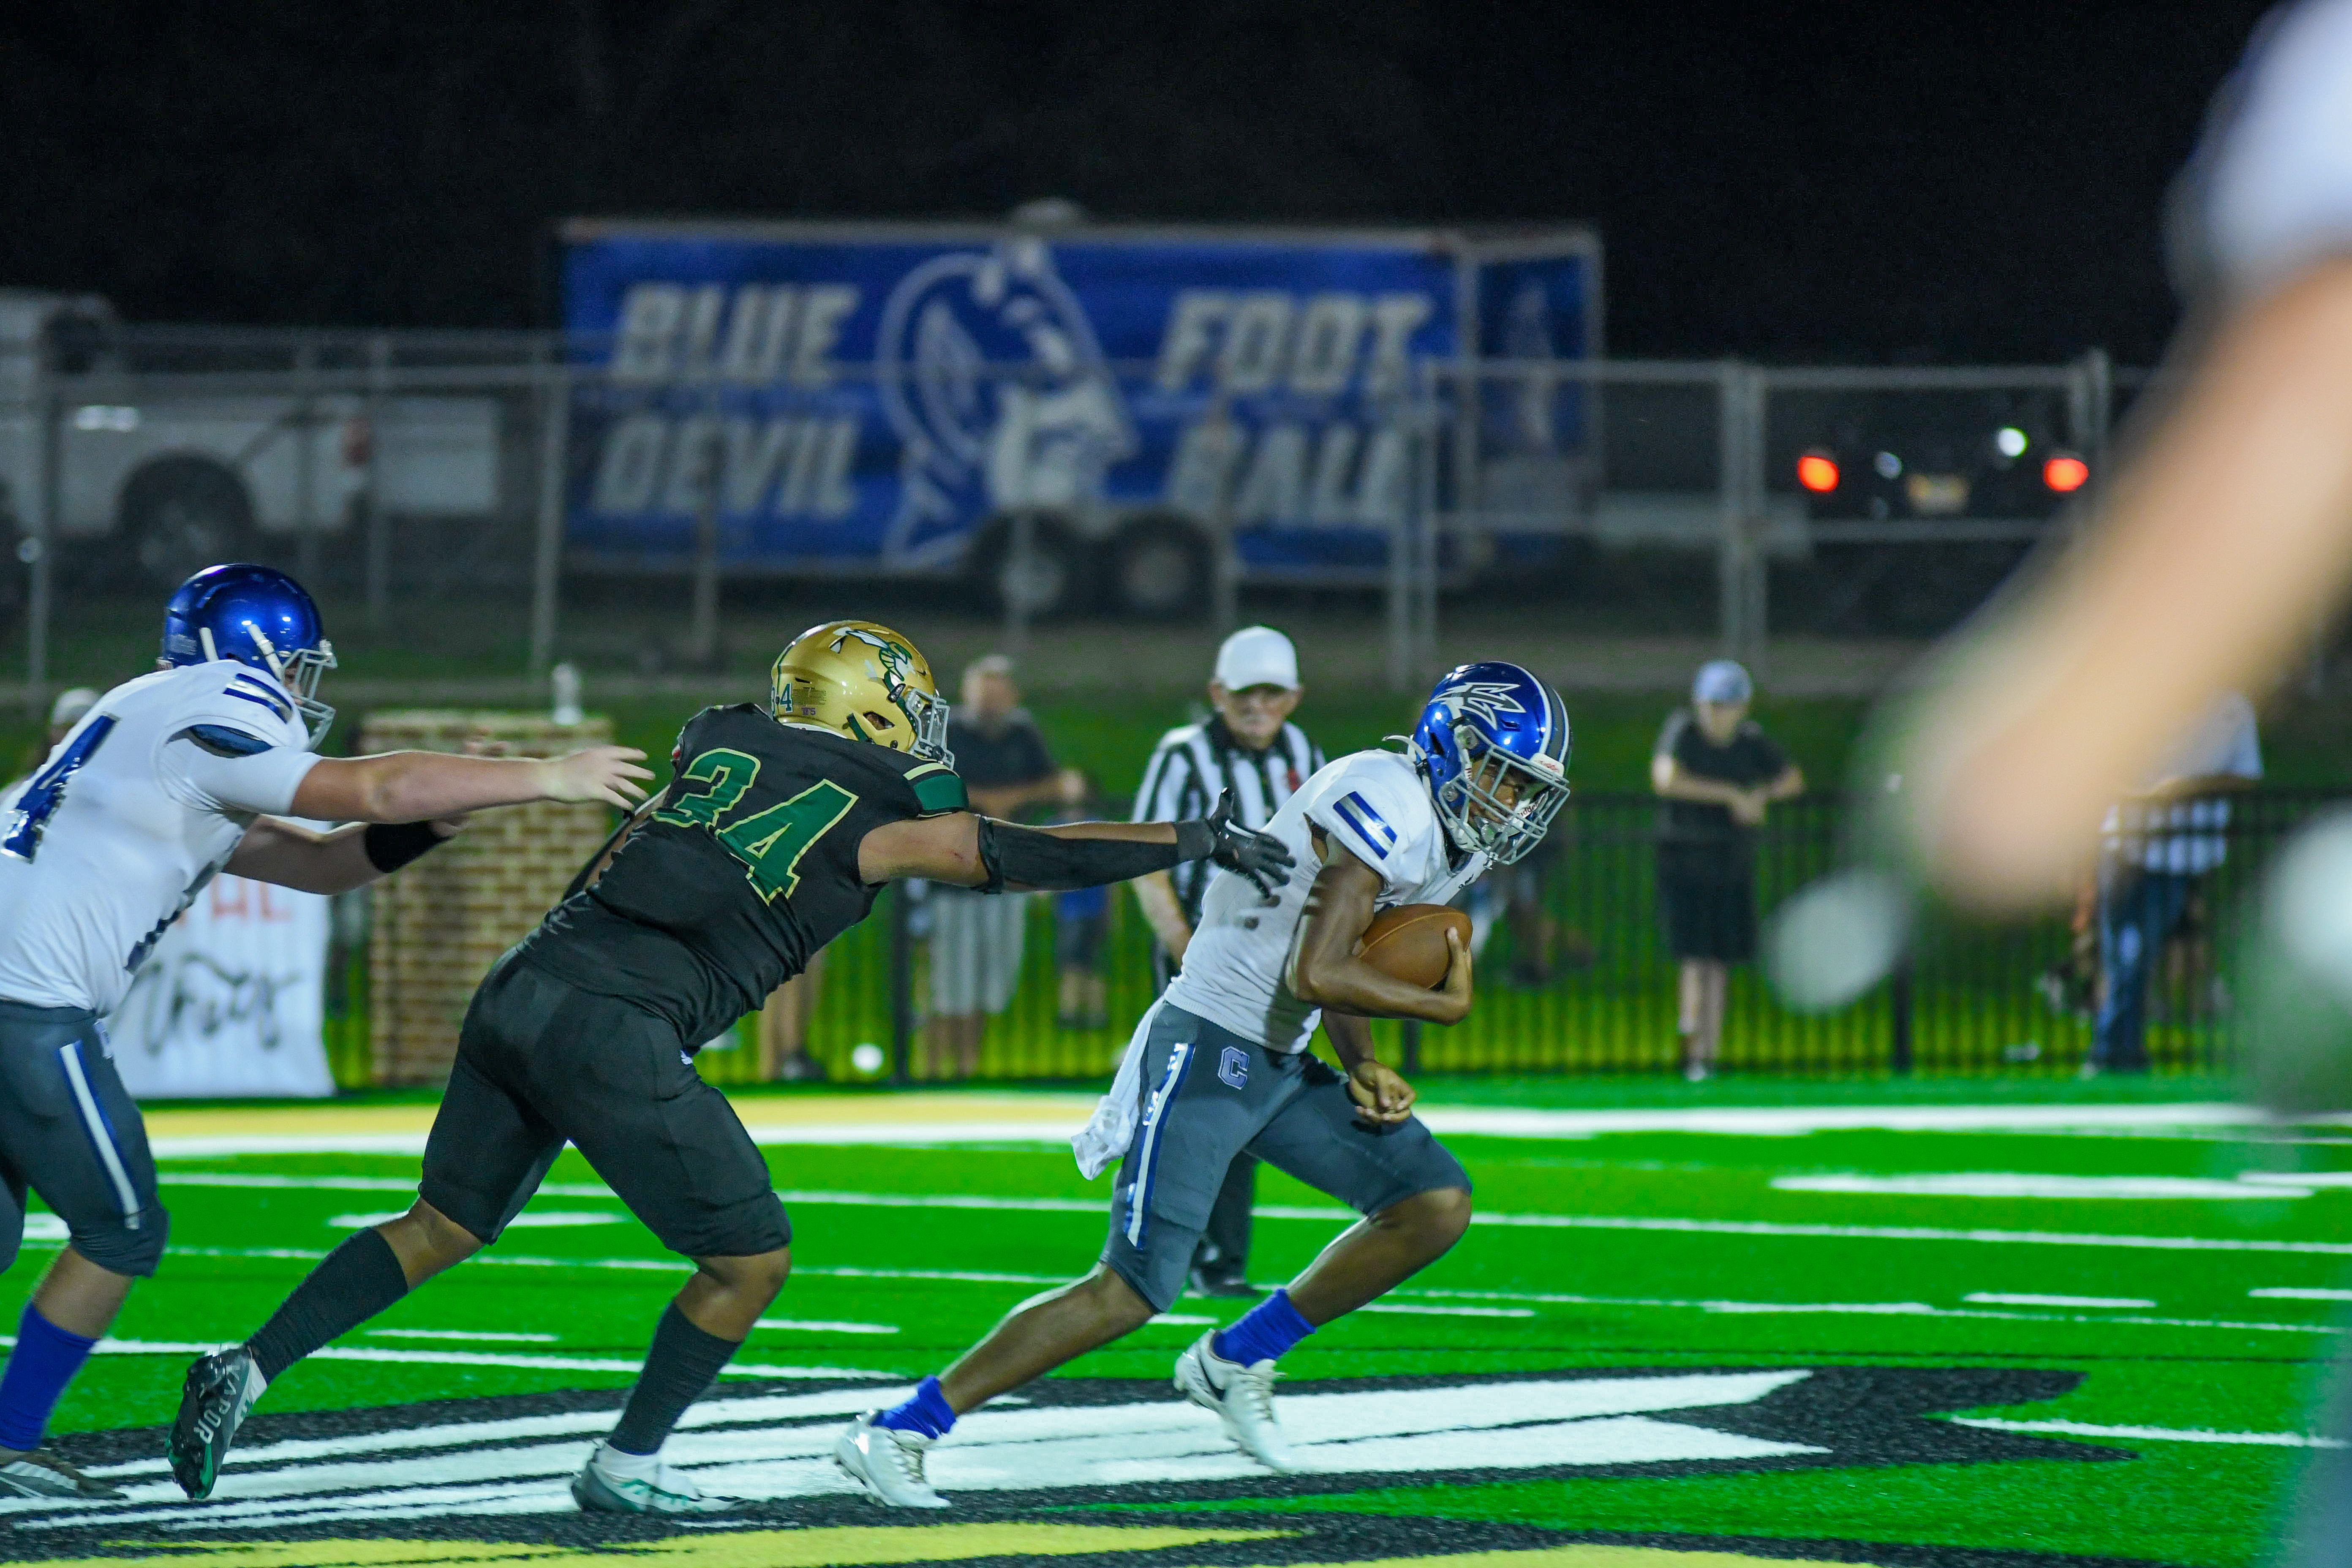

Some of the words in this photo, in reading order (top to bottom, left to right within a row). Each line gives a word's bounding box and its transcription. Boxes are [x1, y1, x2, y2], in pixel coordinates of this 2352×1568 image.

[612, 284, 860, 384] BLUE
[1157, 292, 1432, 392] FOOT
[593, 419, 860, 514] DEVIL
[1217, 1045, 1250, 1090] C
[194, 1365, 240, 1444] VAPOR
